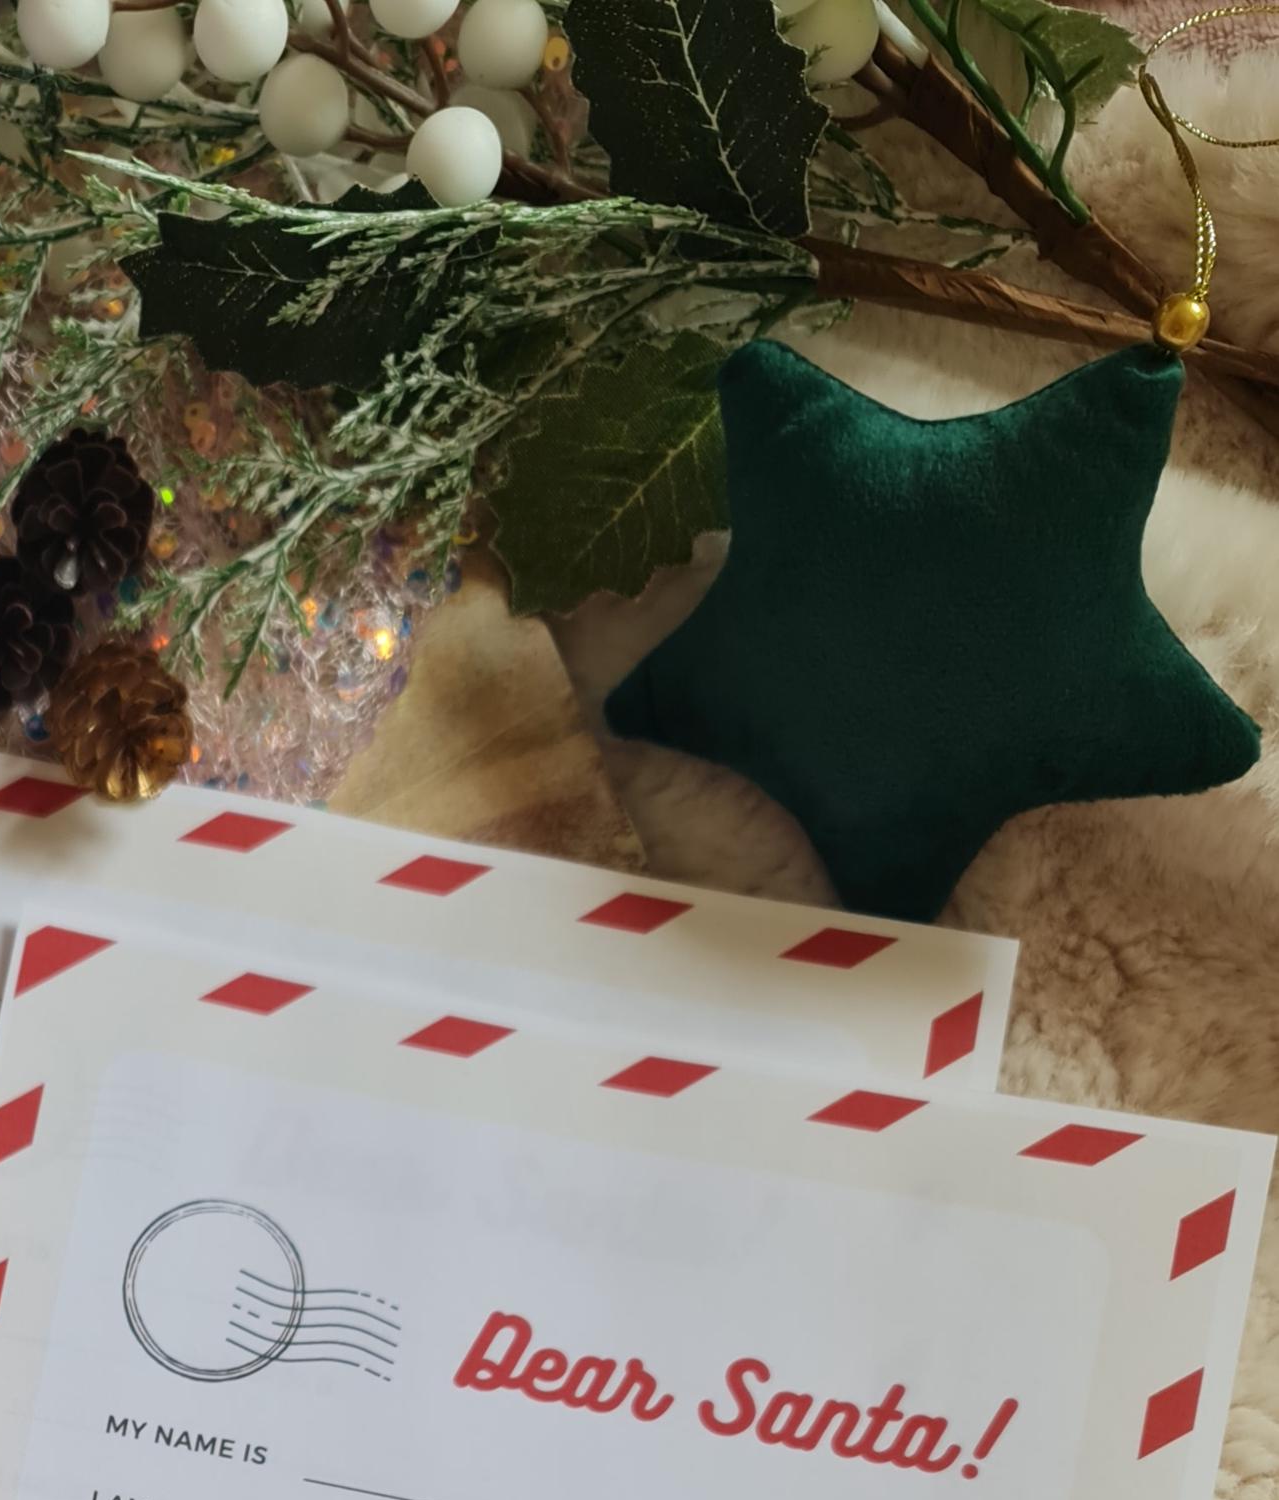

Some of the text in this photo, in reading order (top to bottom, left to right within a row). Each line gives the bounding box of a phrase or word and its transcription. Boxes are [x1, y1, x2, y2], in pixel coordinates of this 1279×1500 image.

[106, 1415, 267, 1464] MY NAME IS
[453, 1312, 1018, 1479] Dear Santa!
